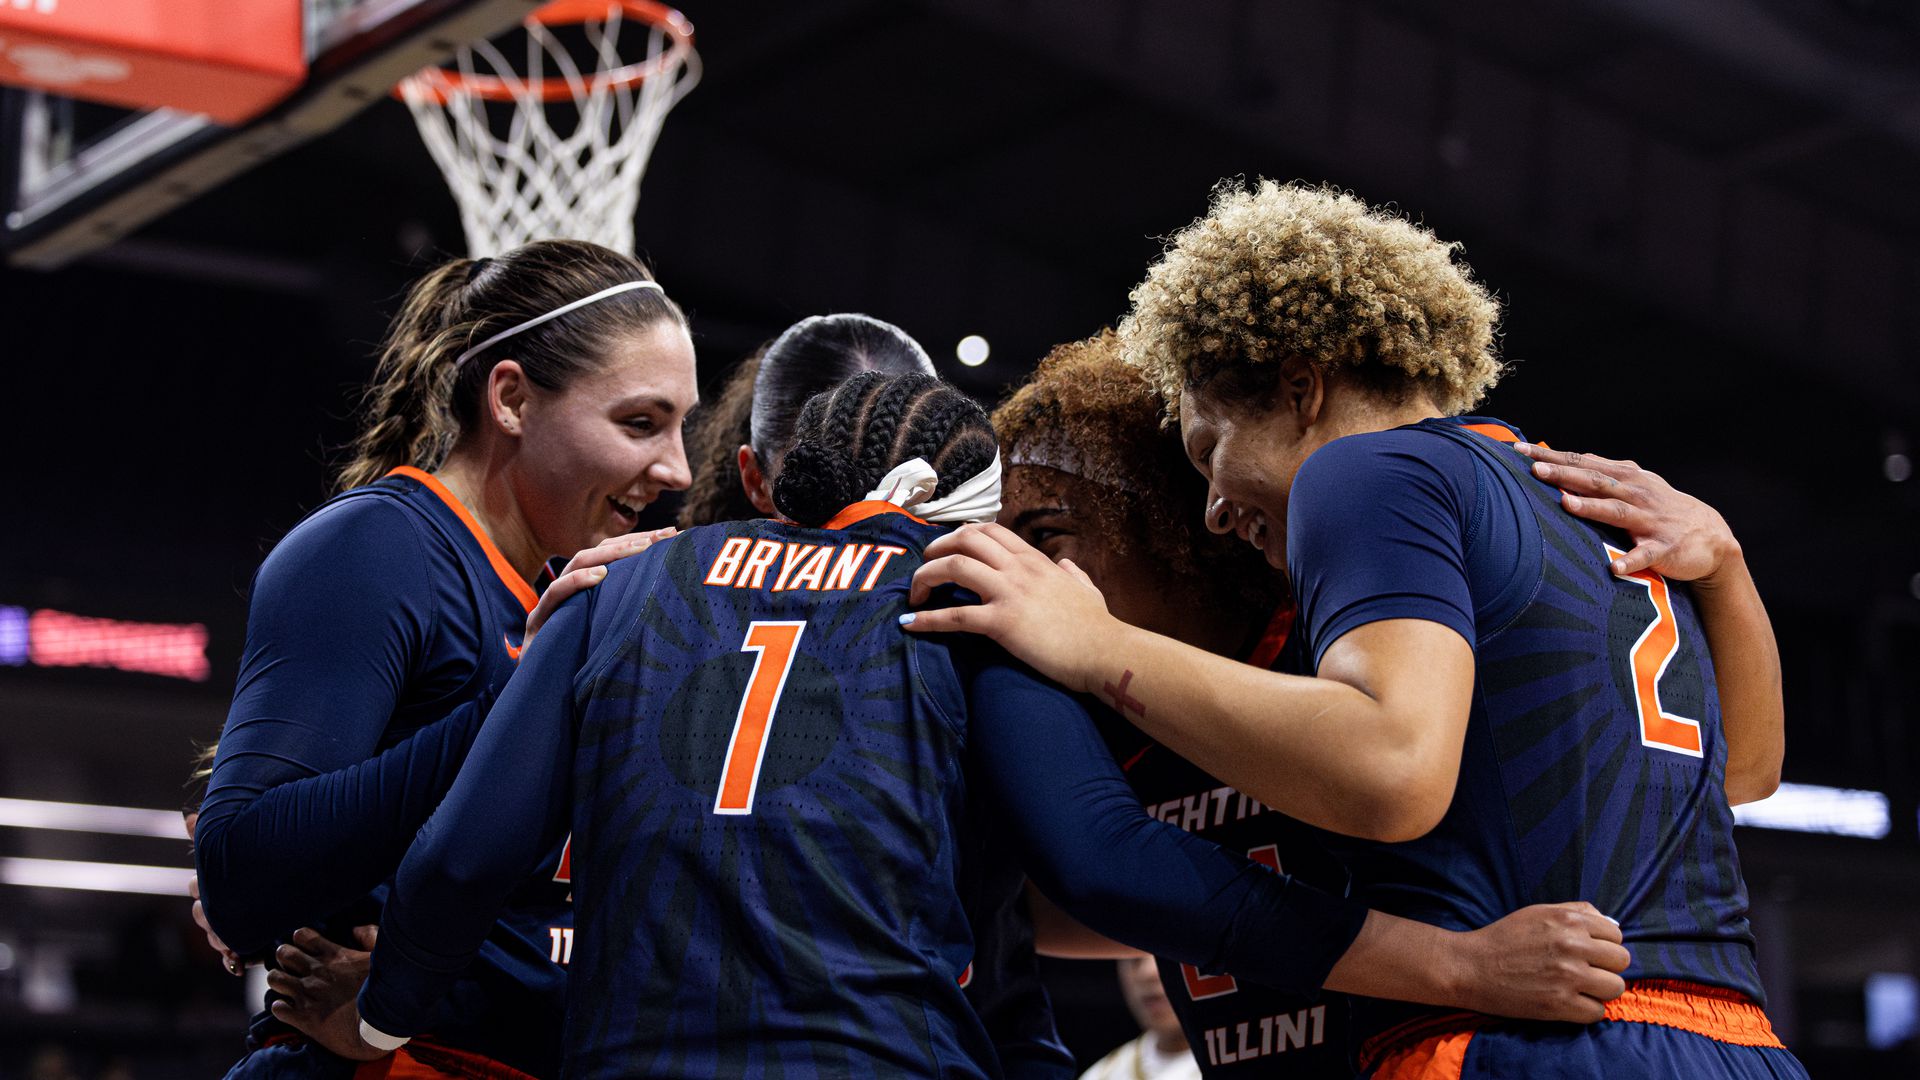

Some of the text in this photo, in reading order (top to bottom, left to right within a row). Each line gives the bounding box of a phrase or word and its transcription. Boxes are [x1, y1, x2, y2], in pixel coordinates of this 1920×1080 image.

[703, 537, 907, 592] BRYANT
[1603, 542, 1703, 758] 2
[713, 620, 807, 816] 1
[1204, 1005, 1326, 1066] ILLINI
